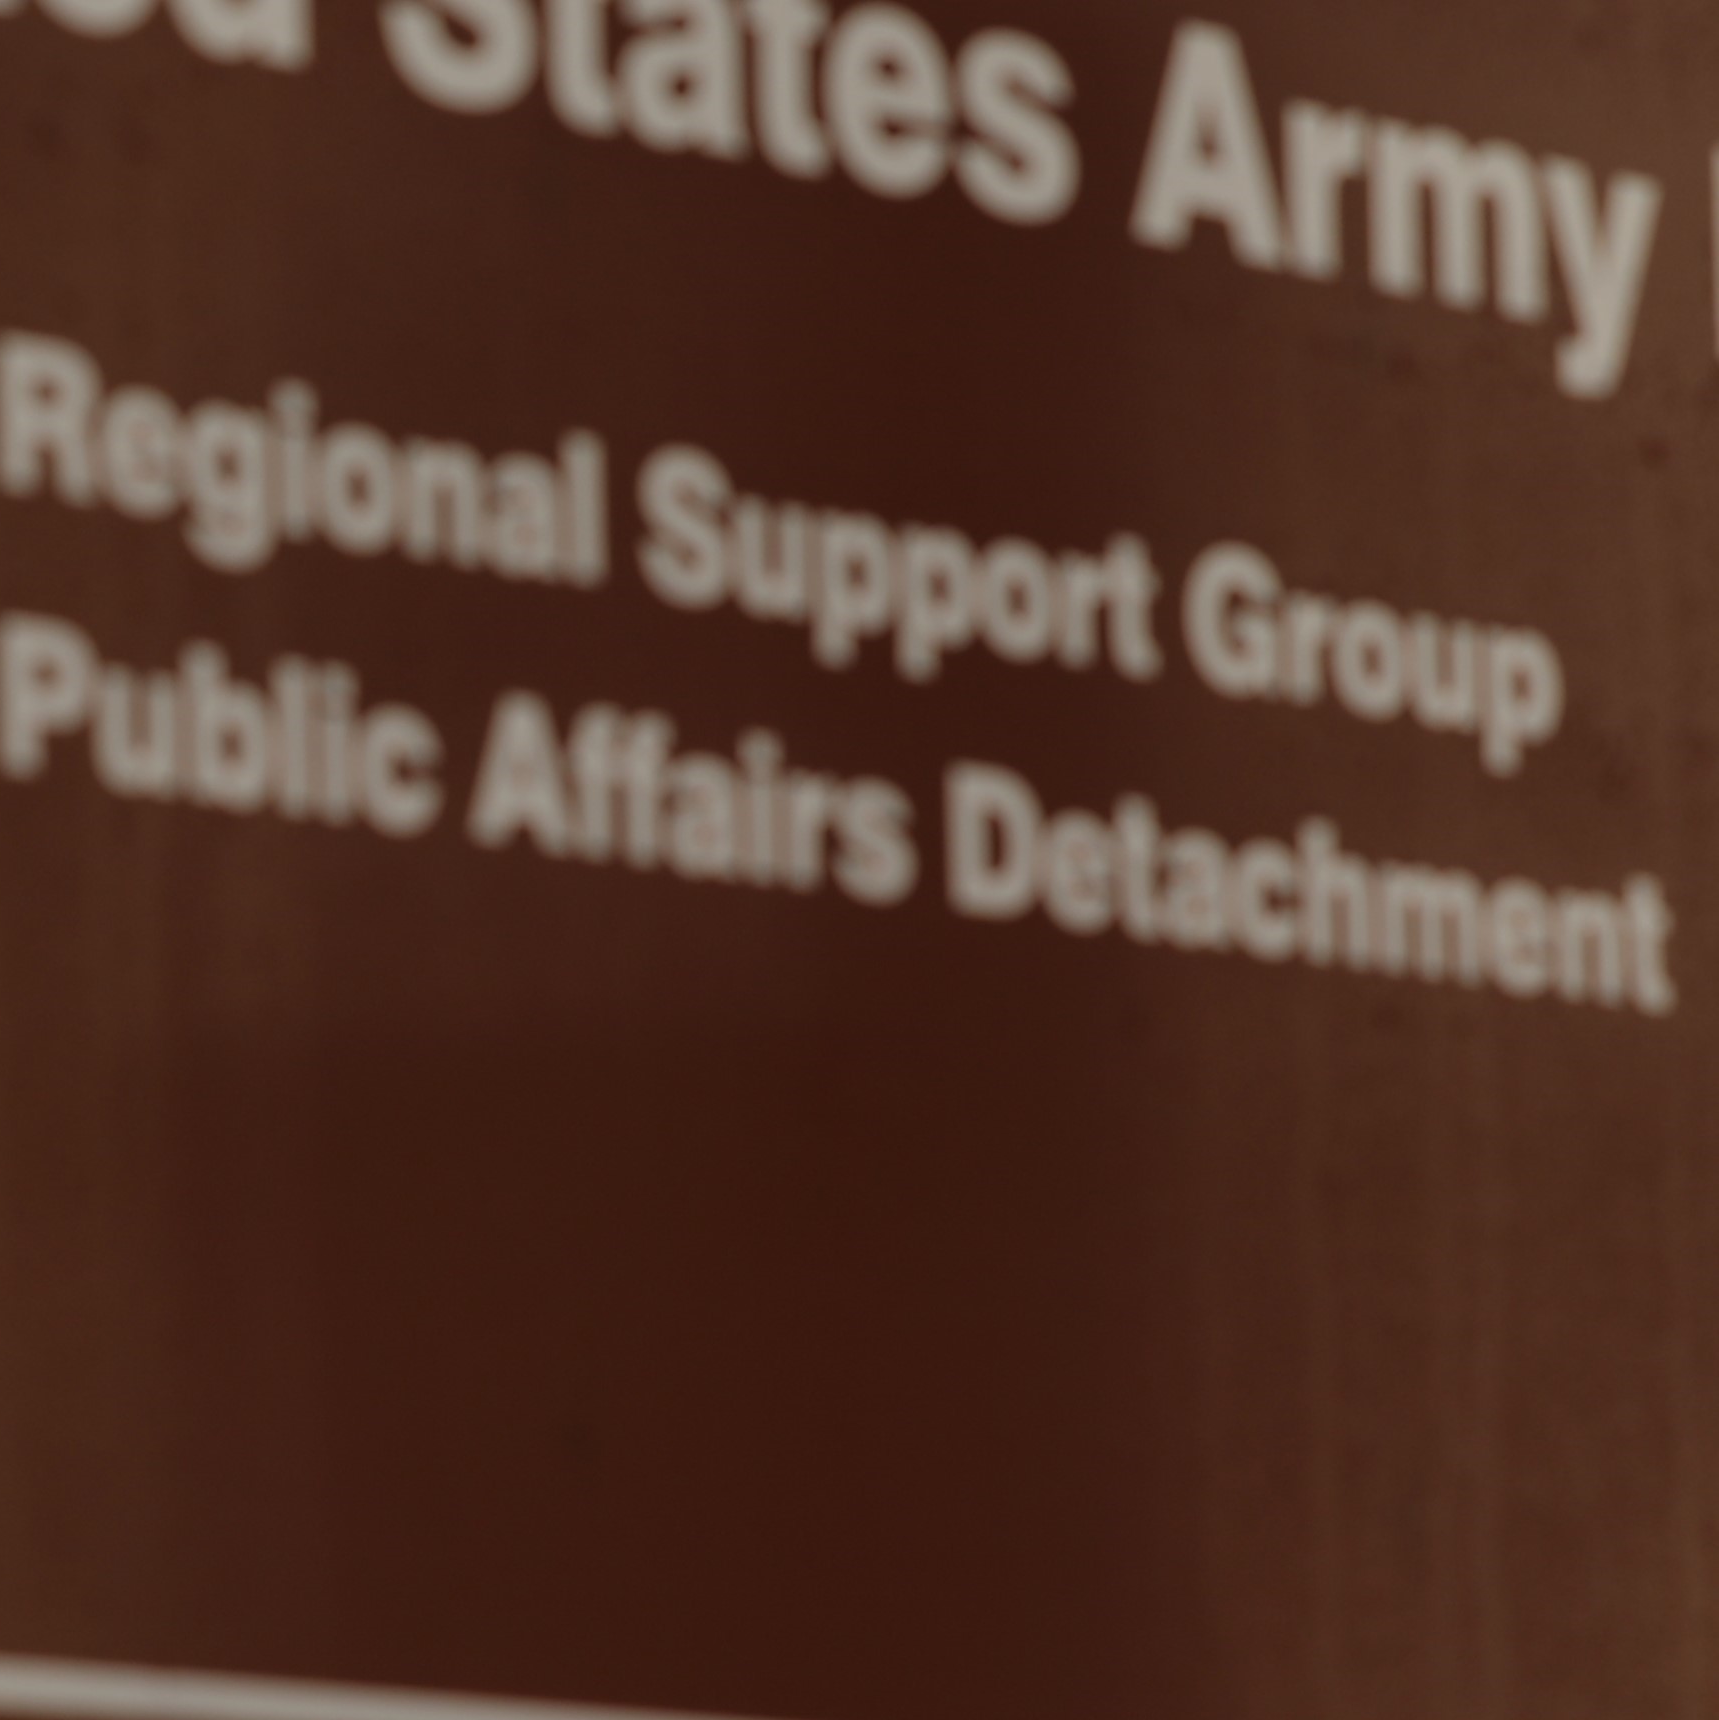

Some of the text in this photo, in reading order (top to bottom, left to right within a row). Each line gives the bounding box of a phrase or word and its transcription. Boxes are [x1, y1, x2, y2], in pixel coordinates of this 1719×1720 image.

[1133, 20, 1662, 399] Army
[639, 448, 1158, 677] Support
[1183, 544, 1563, 773] Group
[470, 695, 915, 902] Affairs
[947, 765, 1675, 1013] Detachment
